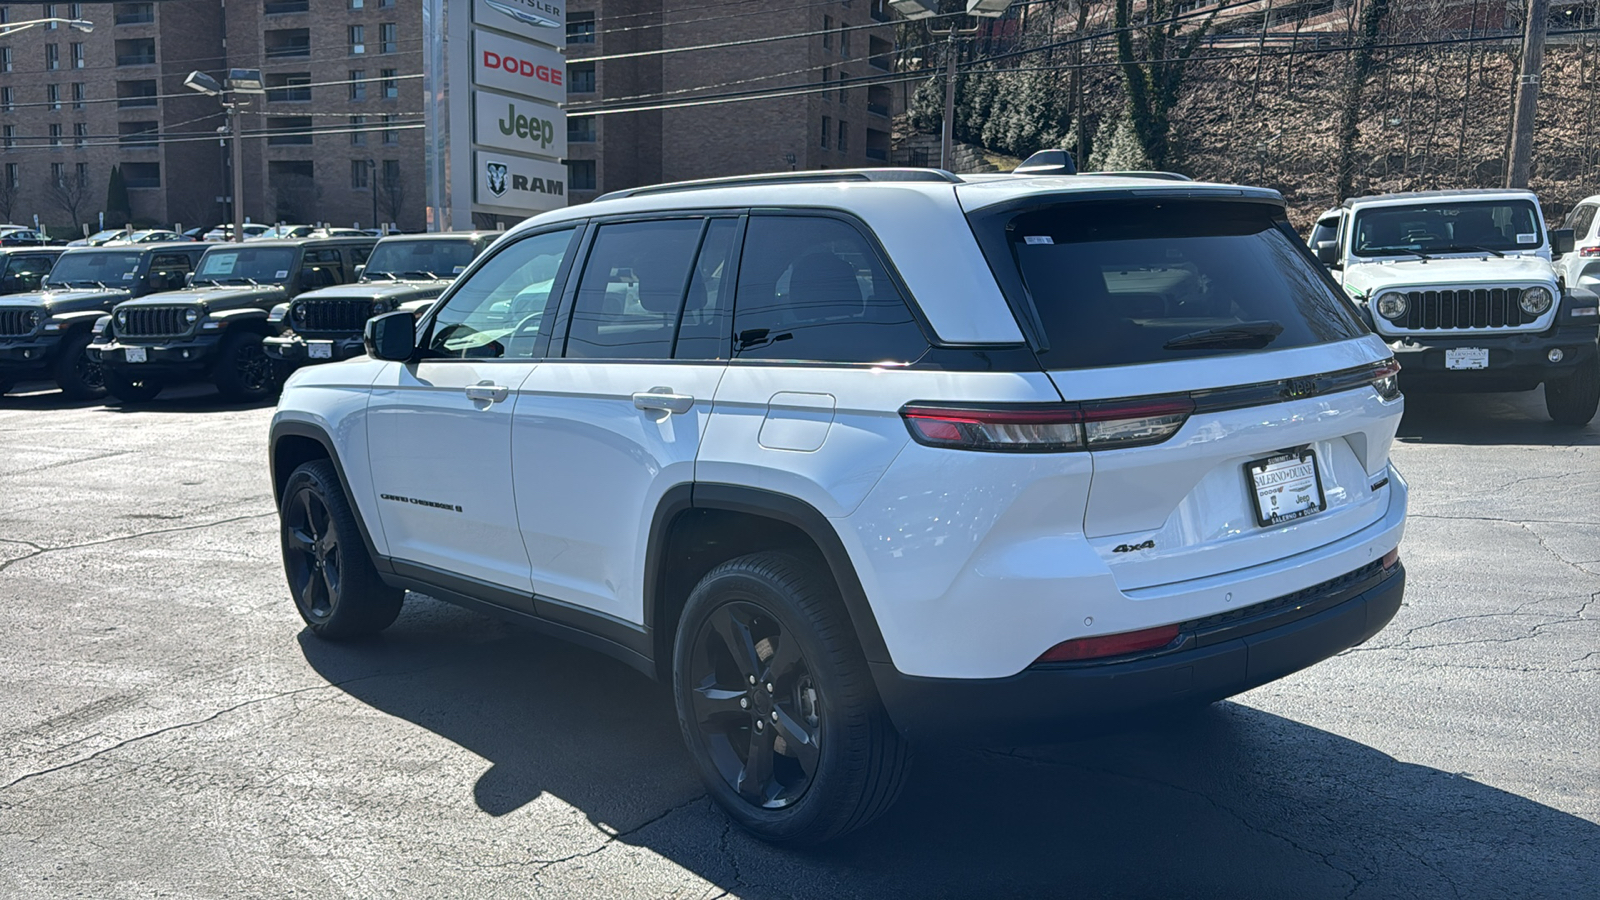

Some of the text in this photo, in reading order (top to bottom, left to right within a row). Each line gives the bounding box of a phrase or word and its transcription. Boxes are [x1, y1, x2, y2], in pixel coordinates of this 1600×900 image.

[483, 50, 563, 86] DODGE
[498, 103, 554, 149] Jeep
[512, 174, 564, 196] RAM
[1288, 379, 1318, 397] Jeep
[1254, 470, 1286, 487] SALERNO
[1289, 464, 1313, 479] DUANE
[380, 493, 455, 511] GRAND CHEROKEE
[1295, 494, 1311, 507] Jeep
[1271, 506, 1321, 524] SALERNO DUANE
[1112, 539, 1155, 553] 4x4
